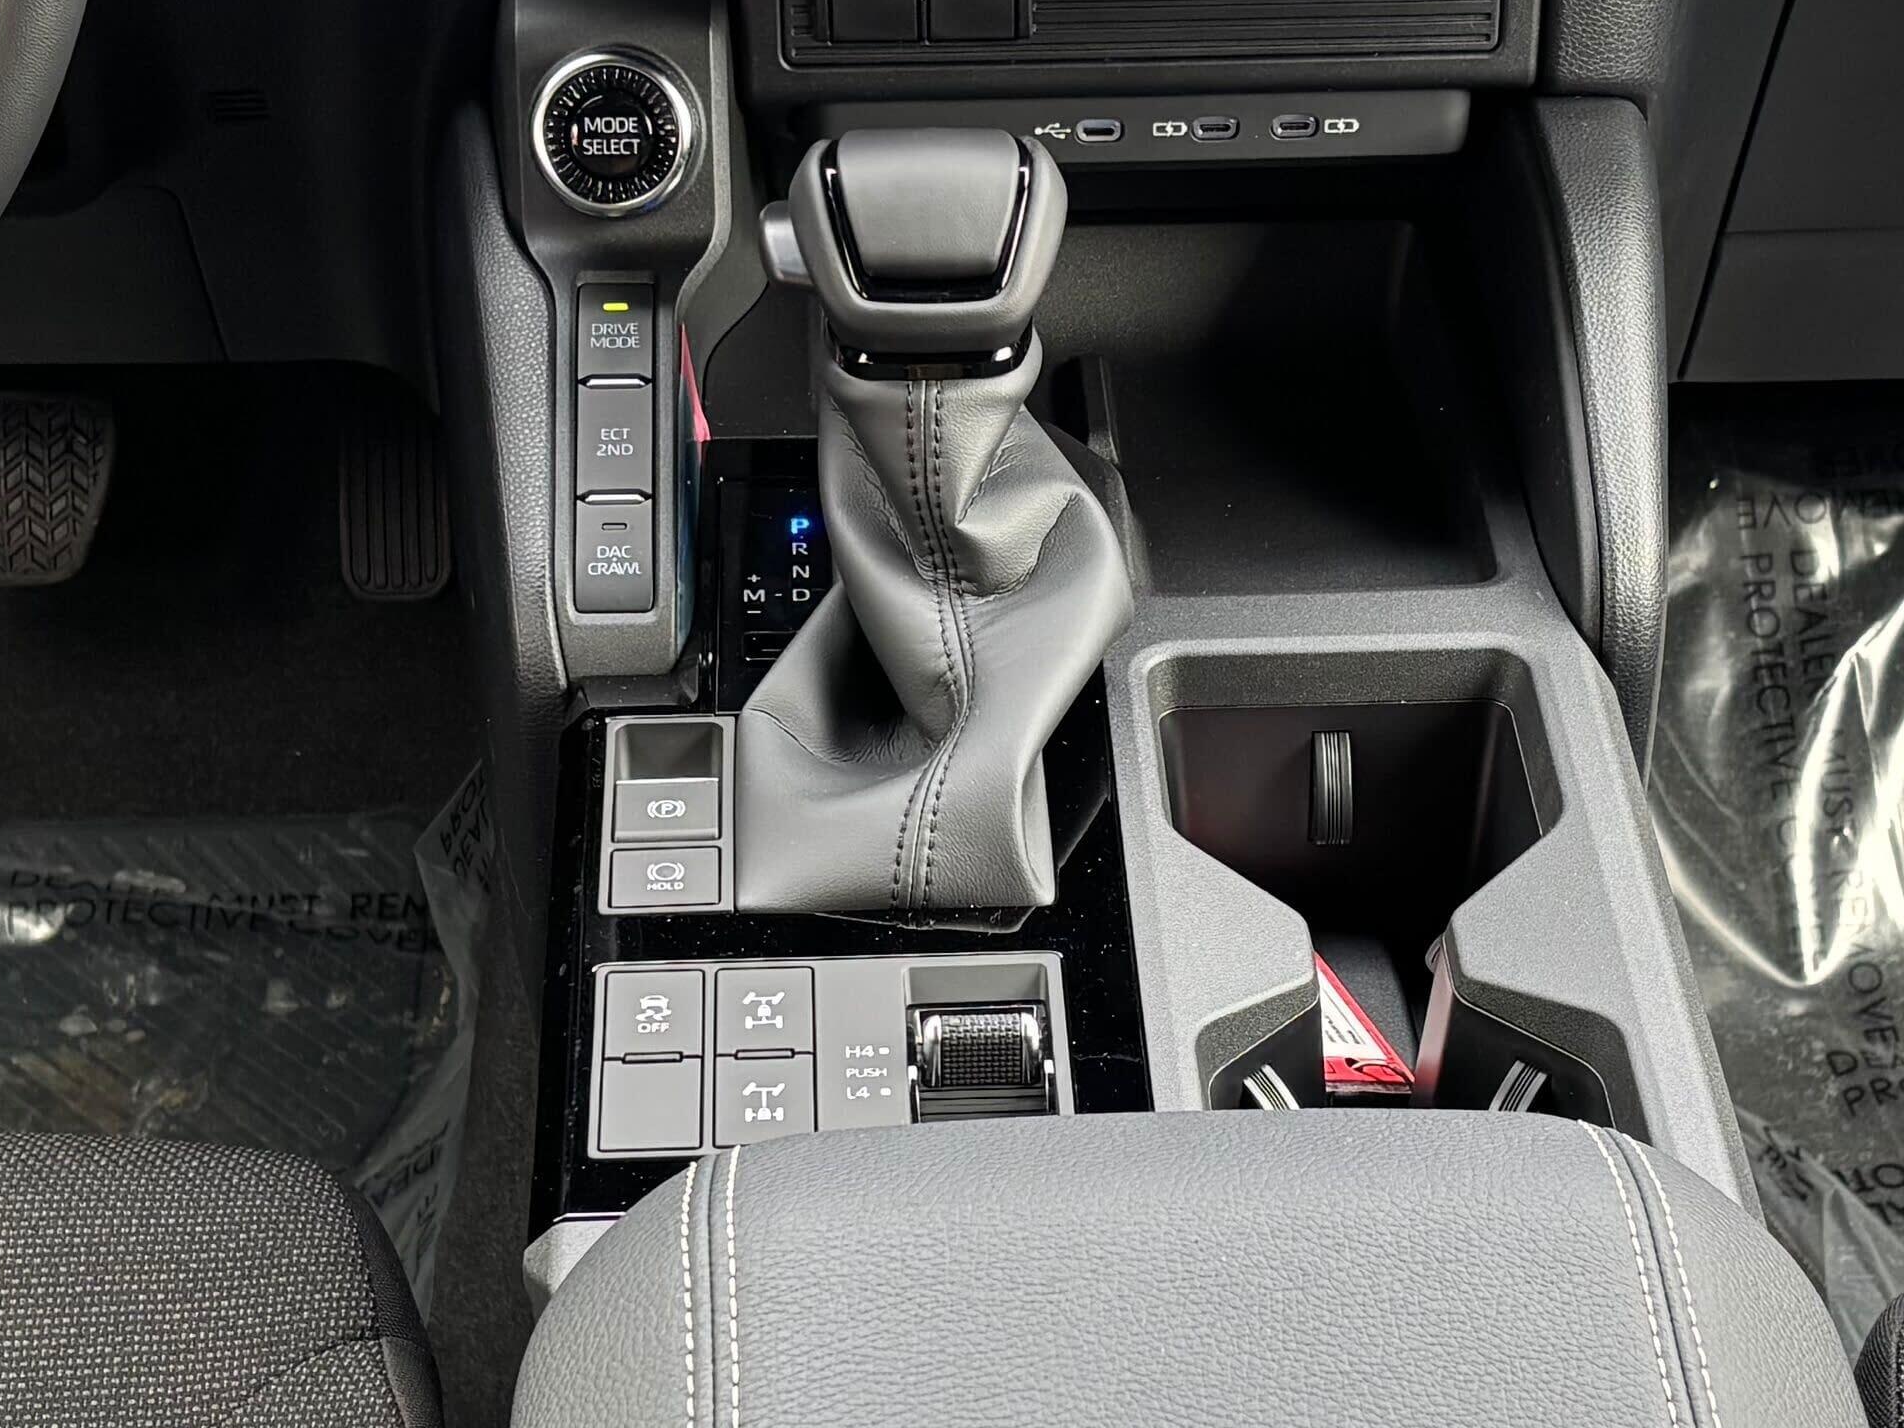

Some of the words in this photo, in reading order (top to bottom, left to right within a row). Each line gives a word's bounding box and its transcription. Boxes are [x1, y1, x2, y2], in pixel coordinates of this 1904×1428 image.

[583, 117, 638, 134] MODE
[582, 139, 641, 156] SELECT
[591, 323, 640, 336] DRIVE
[590, 336, 641, 349] MODE
[600, 427, 631, 441] ECT
[596, 443, 634, 457] 2ND
[790, 517, 810, 534] P
[597, 544, 632, 560] DAC
[792, 541, 809, 556] R
[588, 560, 642, 576] CRAWL
[792, 564, 811, 579] N
[743, 589, 767, 603] M
[791, 588, 812, 602] D
[646, 881, 684, 891] HOLD
[637, 1022, 670, 1035] OFF
[845, 1044, 875, 1060] H4
[845, 1066, 889, 1078] PUSH
[846, 1086, 871, 1100] L4
